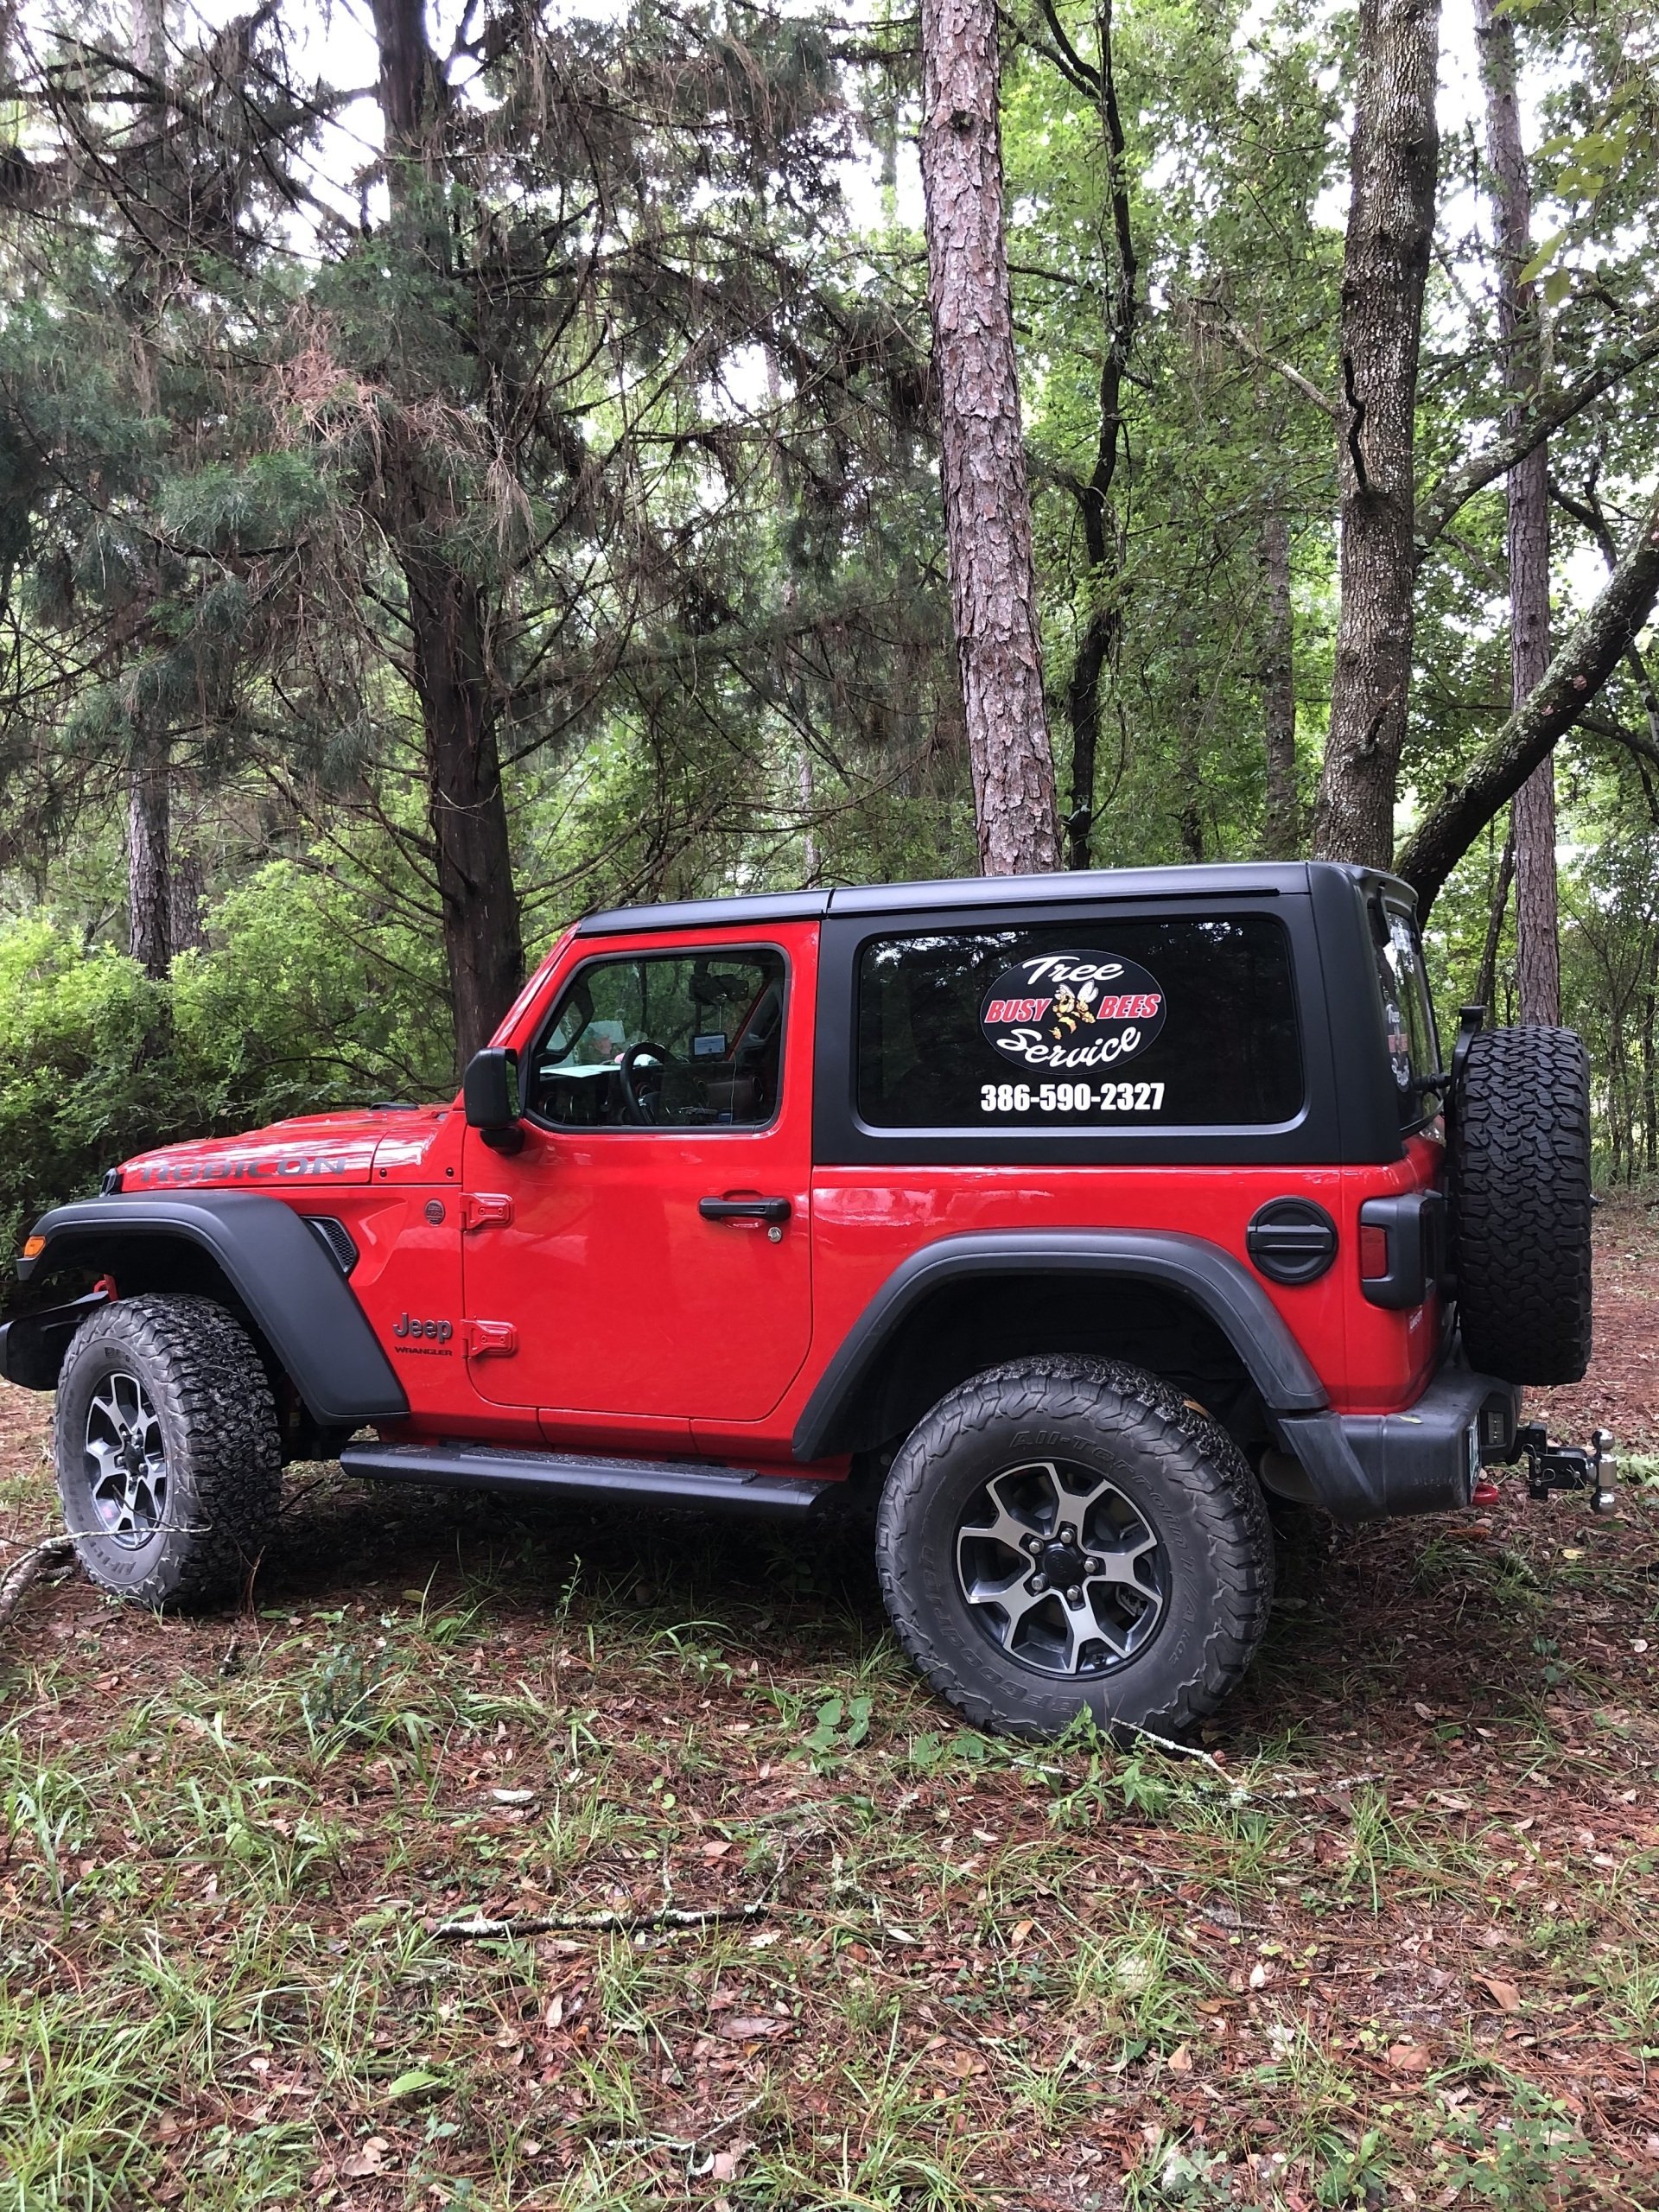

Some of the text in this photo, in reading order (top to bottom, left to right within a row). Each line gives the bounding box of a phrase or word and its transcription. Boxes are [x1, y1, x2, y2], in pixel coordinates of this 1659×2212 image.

[1022, 956, 1124, 985] Tree
[984, 994, 1161, 1023] BUSY BEES
[996, 1027, 1141, 1068] Service
[981, 1083, 1165, 1111] 386-590-2327
[140, 1157, 346, 1183] RUBICON
[392, 1313, 453, 1344] Jeep
[394, 1346, 453, 1357] WRANGLER
